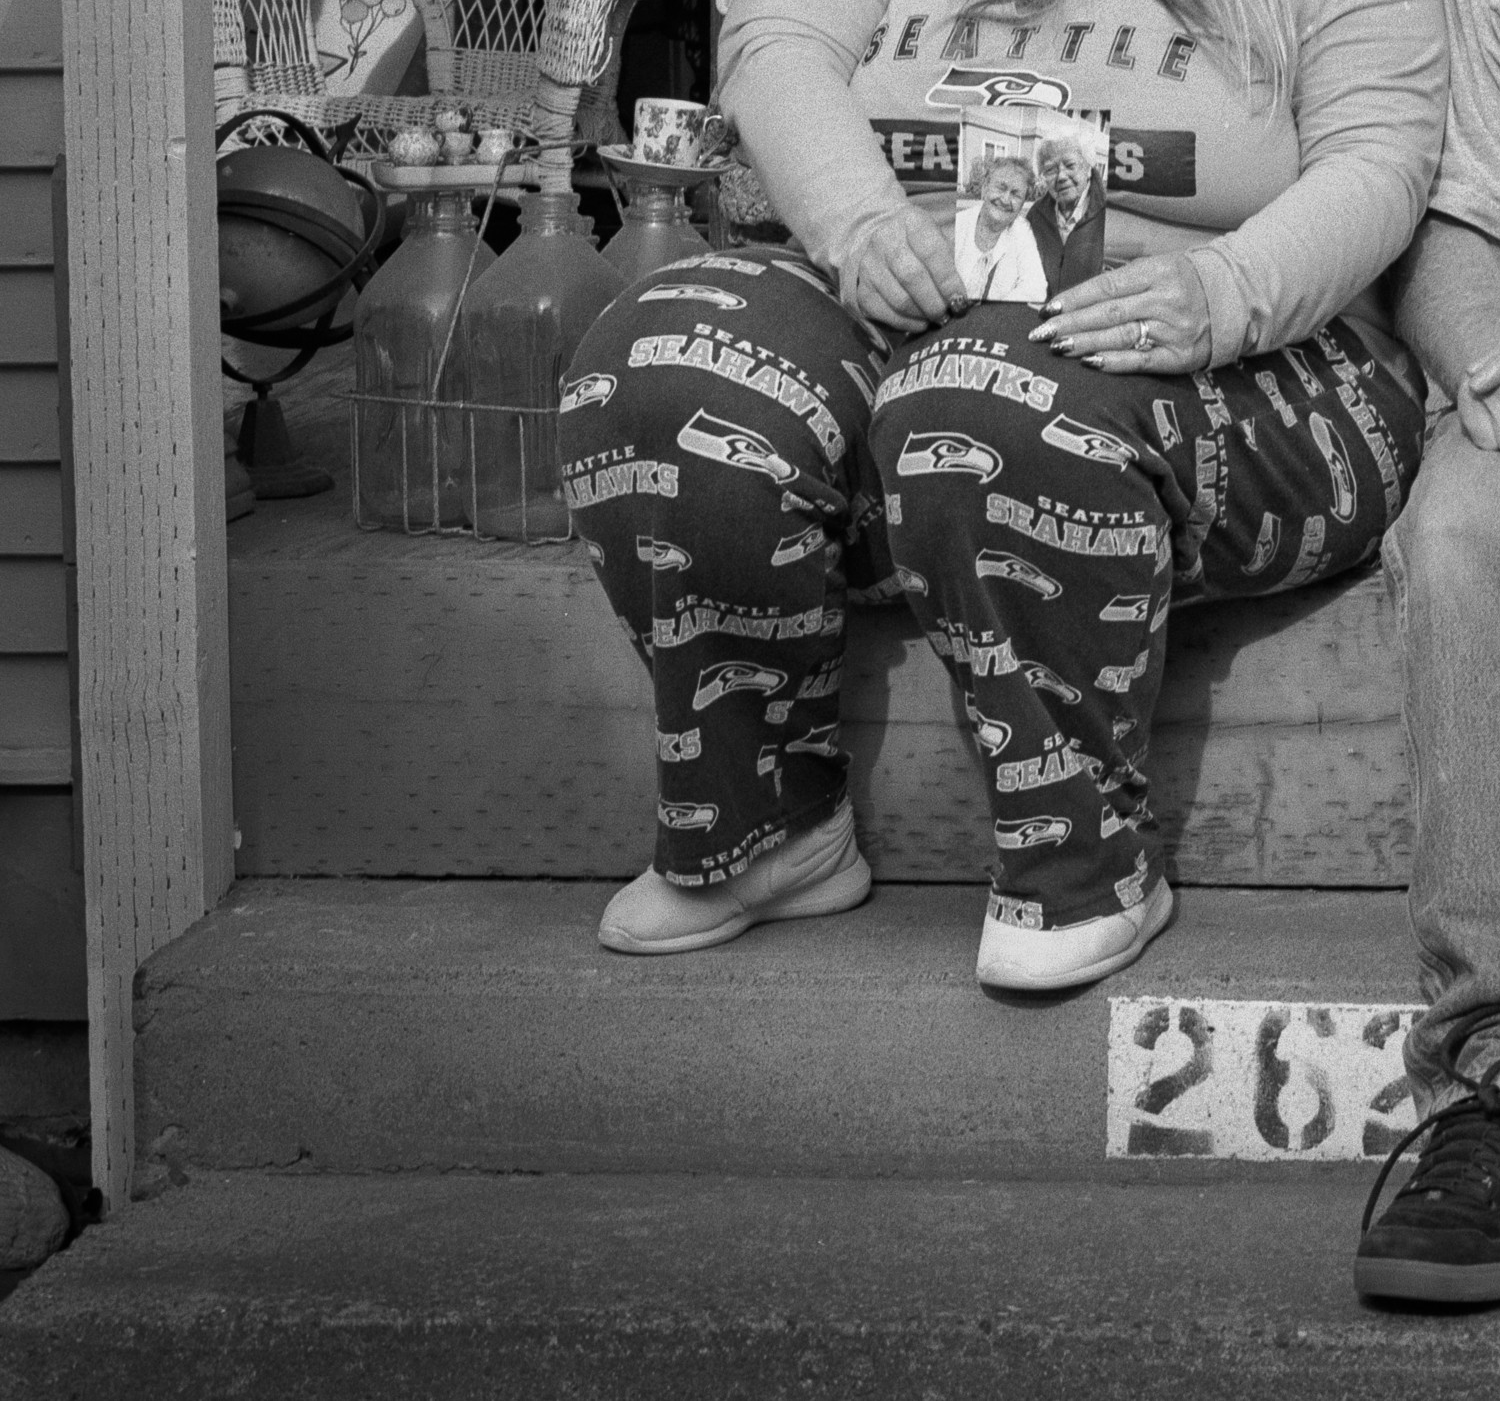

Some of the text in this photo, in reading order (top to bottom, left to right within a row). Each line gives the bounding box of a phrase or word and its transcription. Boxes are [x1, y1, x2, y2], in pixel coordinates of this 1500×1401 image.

[860, 13, 1199, 82] SEATTLE
[693, 321, 830, 401] SEATTLE
[908, 337, 1010, 365] SEATTLE
[627, 334, 846, 466] SEAHAWKS
[873, 353, 1060, 413] SEAHAWKS
[561, 444, 636, 478] SEATTLE
[1037, 494, 1146, 526] SEATTLE
[652, 605, 824, 649] EAHAWKS
[675, 593, 781, 617] SEATTLE
